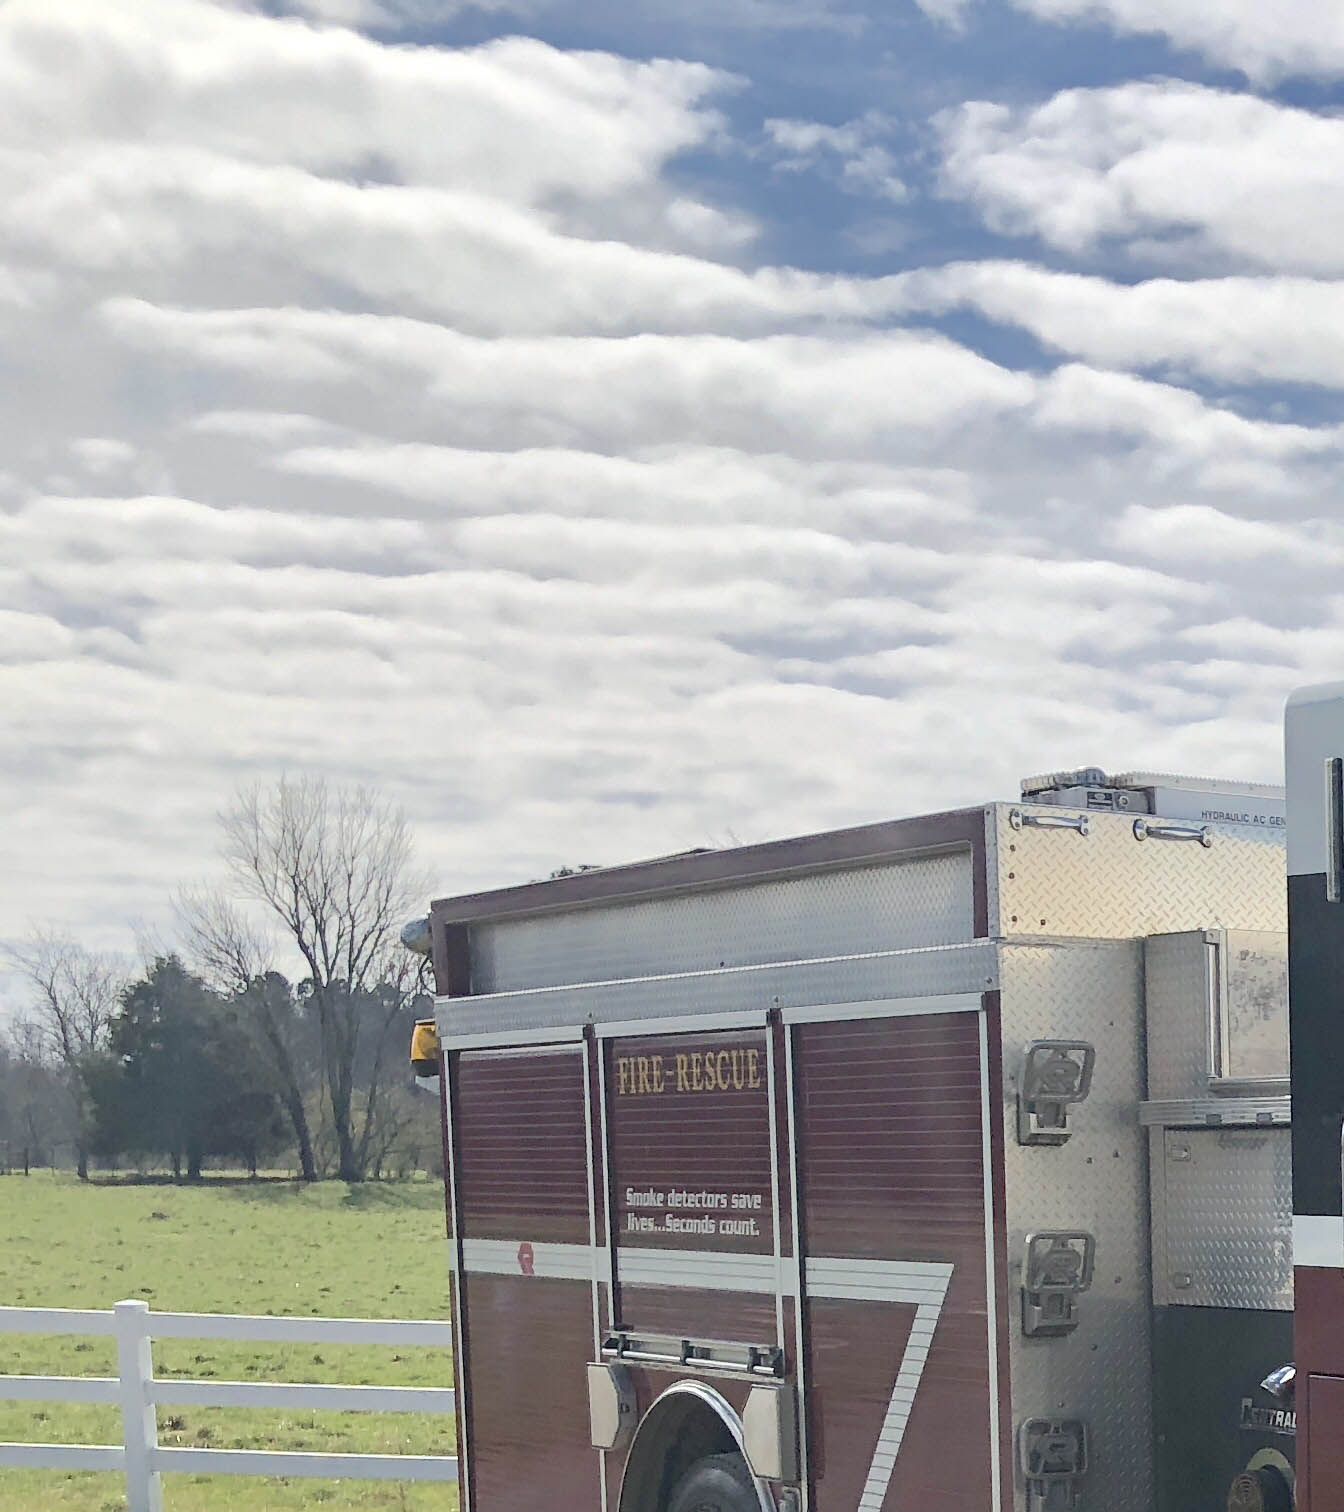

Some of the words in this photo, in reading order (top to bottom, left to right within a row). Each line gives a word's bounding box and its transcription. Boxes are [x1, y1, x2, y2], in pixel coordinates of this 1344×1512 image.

[1201, 811, 1249, 822] HYDRAULIC
[1253, 815, 1266, 824] AC
[626, 1187, 664, 1207] Smoke
[667, 1189, 727, 1209] detectors
[731, 1193, 762, 1209] save
[719, 1217, 760, 1236] count.
